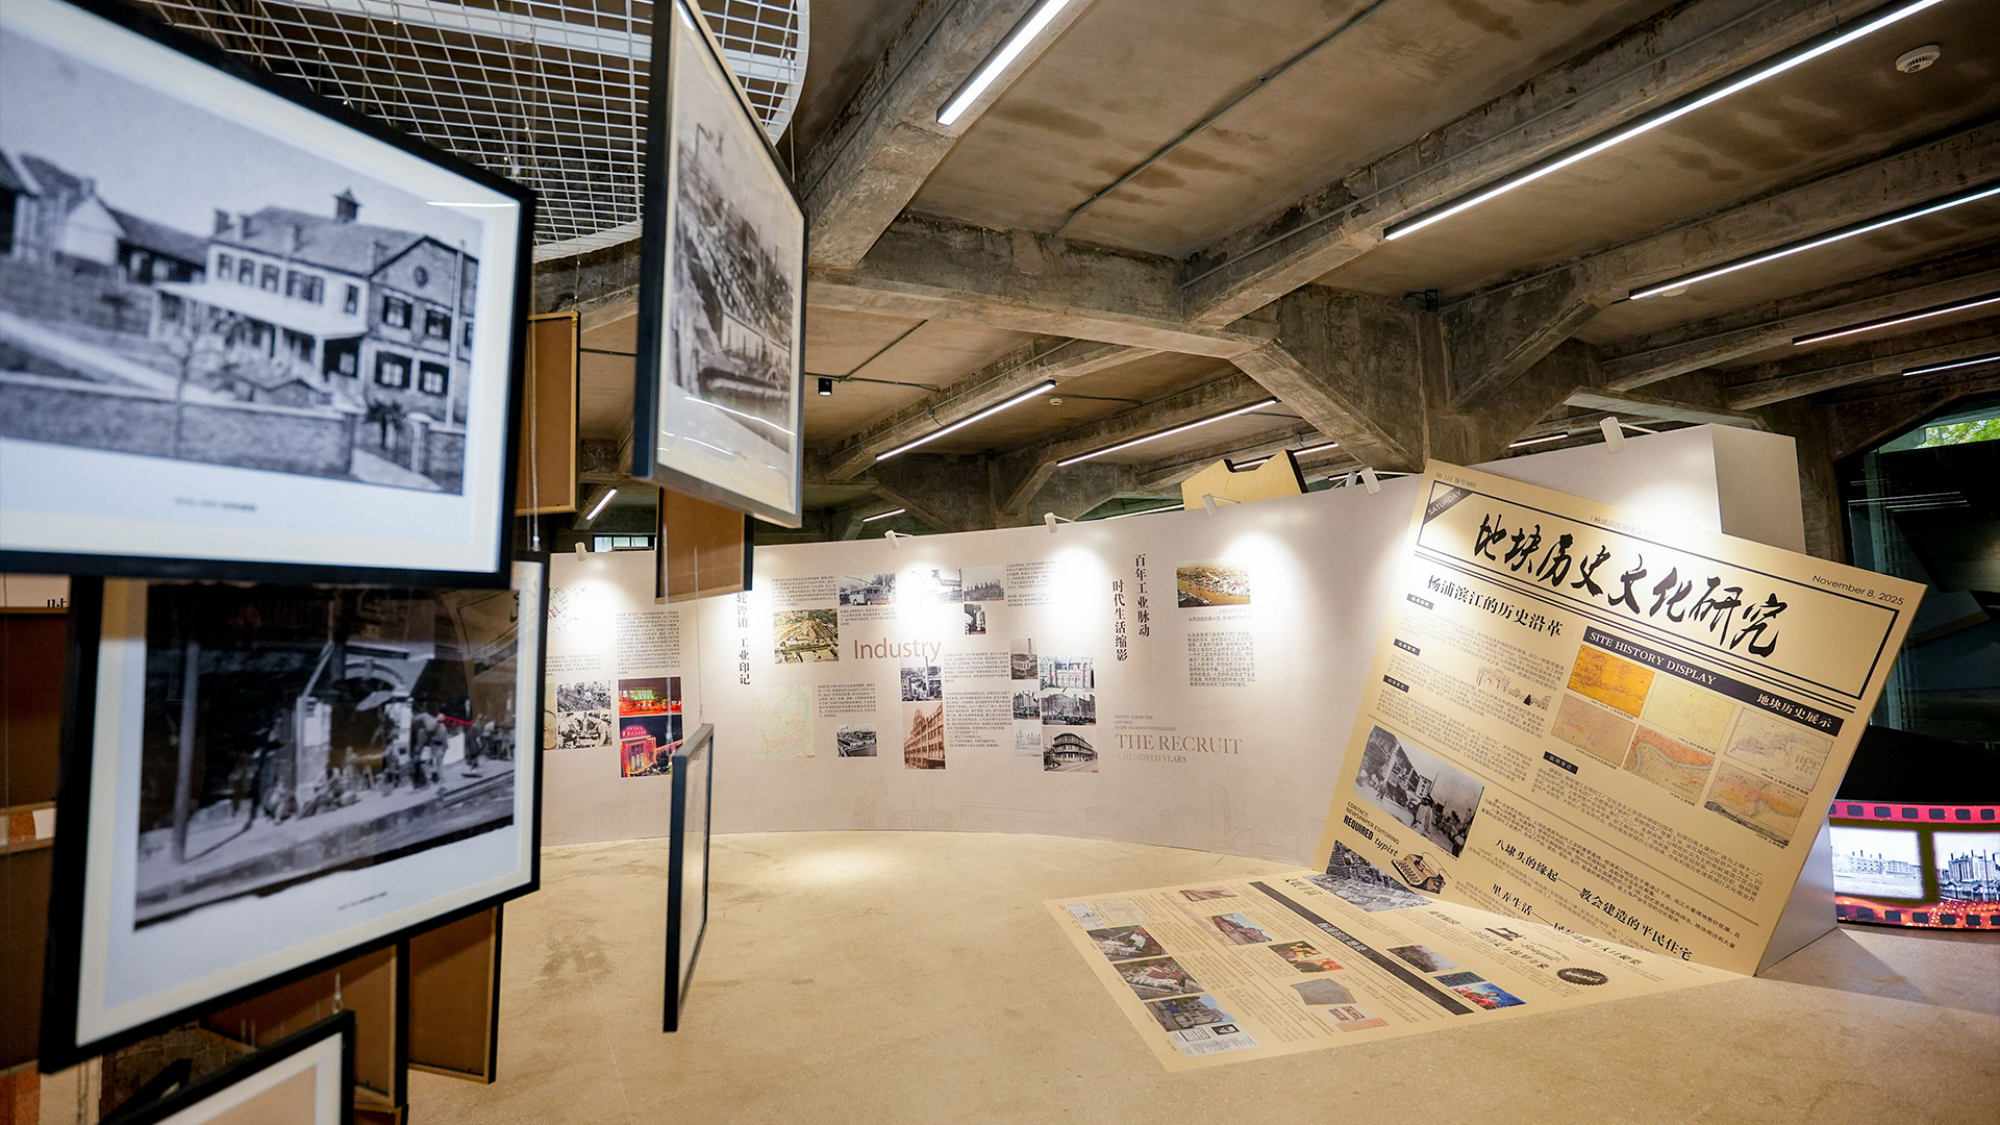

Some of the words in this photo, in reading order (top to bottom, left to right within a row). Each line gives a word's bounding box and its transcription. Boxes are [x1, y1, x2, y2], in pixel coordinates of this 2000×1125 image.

[1427, 488, 1462, 516] SATURDAY
[1135, 553, 1150, 637] 百年工业脉动
[1473, 512, 1787, 659] 地块历史文化研究
[1812, 575, 1865, 596] November
[1866, 589, 1877, 599] 8,
[1878, 592, 1905, 606] 2025
[1112, 579, 1128, 661] 时代生活缩影
[1427, 573, 1564, 639] 杨浦滨江的历史沿革
[739, 637, 751, 685] 工业印记
[854, 637, 941, 662] Industry
[1589, 631, 1613, 648] SITE
[1614, 640, 1665, 666] HISTORY
[1666, 660, 1717, 686] DISPLAY
[1756, 693, 1833, 729] 地块历史展示
[1114, 733, 1154, 750] THE
[1158, 734, 1243, 755] RECRUIT
[1123, 753, 1161, 762] HUNDRED
[1162, 754, 1188, 763] YEARS
[1343, 814, 1374, 841] REQUIRED
[1374, 838, 1399, 857] typist
[1346, 807, 1375, 828] NEWSPAPER
[1374, 825, 1399, 845] EDITORING
